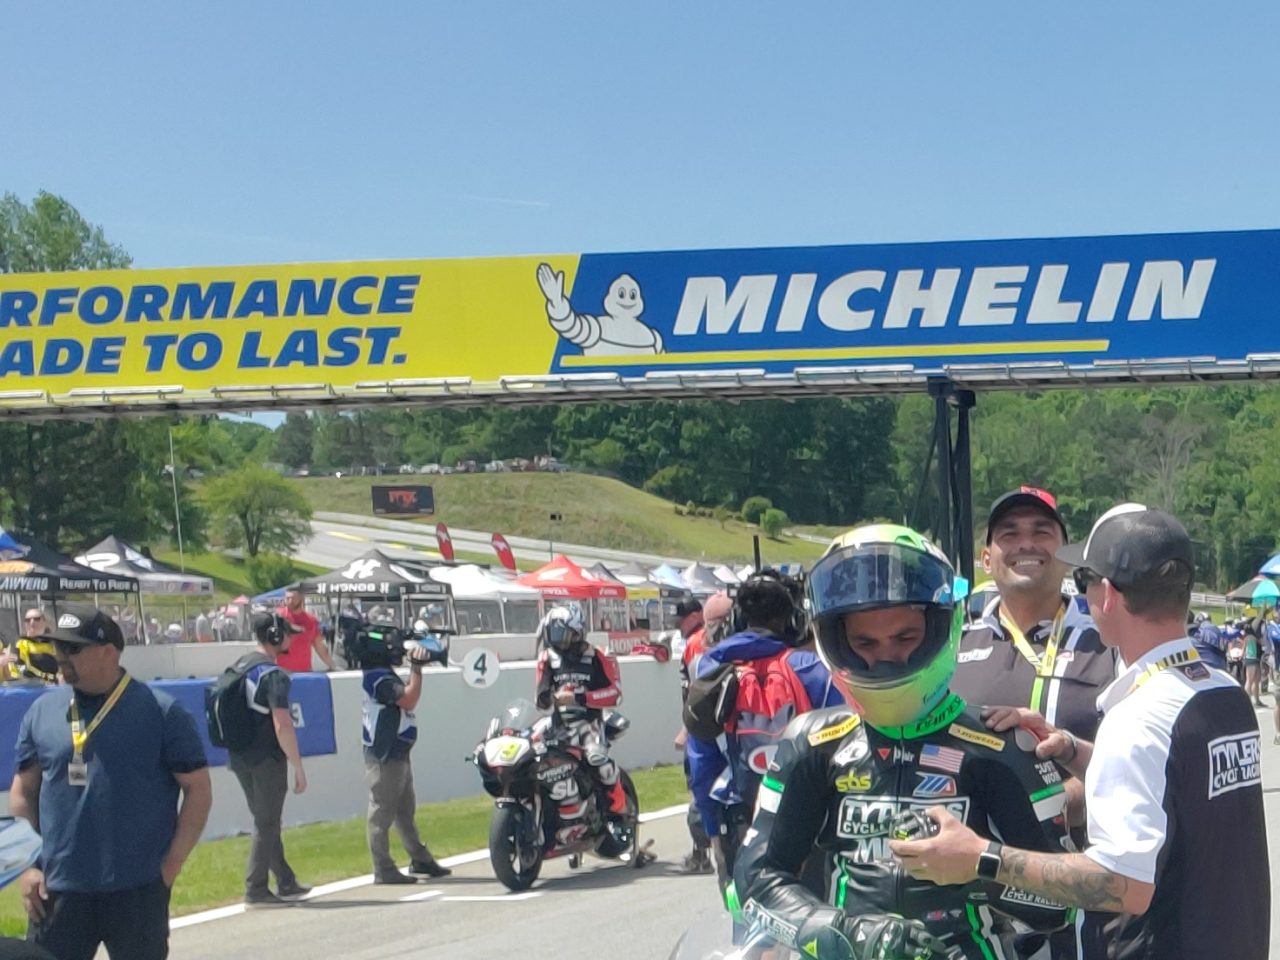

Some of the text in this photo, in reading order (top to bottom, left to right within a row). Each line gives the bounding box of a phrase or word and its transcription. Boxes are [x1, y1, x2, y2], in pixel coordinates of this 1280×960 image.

[0, 275, 421, 328] RFORMANCE
[672, 258, 1217, 336] MICHELIN
[145, 333, 223, 373] TO
[238, 326, 408, 370] LAST.
[473, 652, 488, 676] 4
[835, 769, 871, 793] sbs
